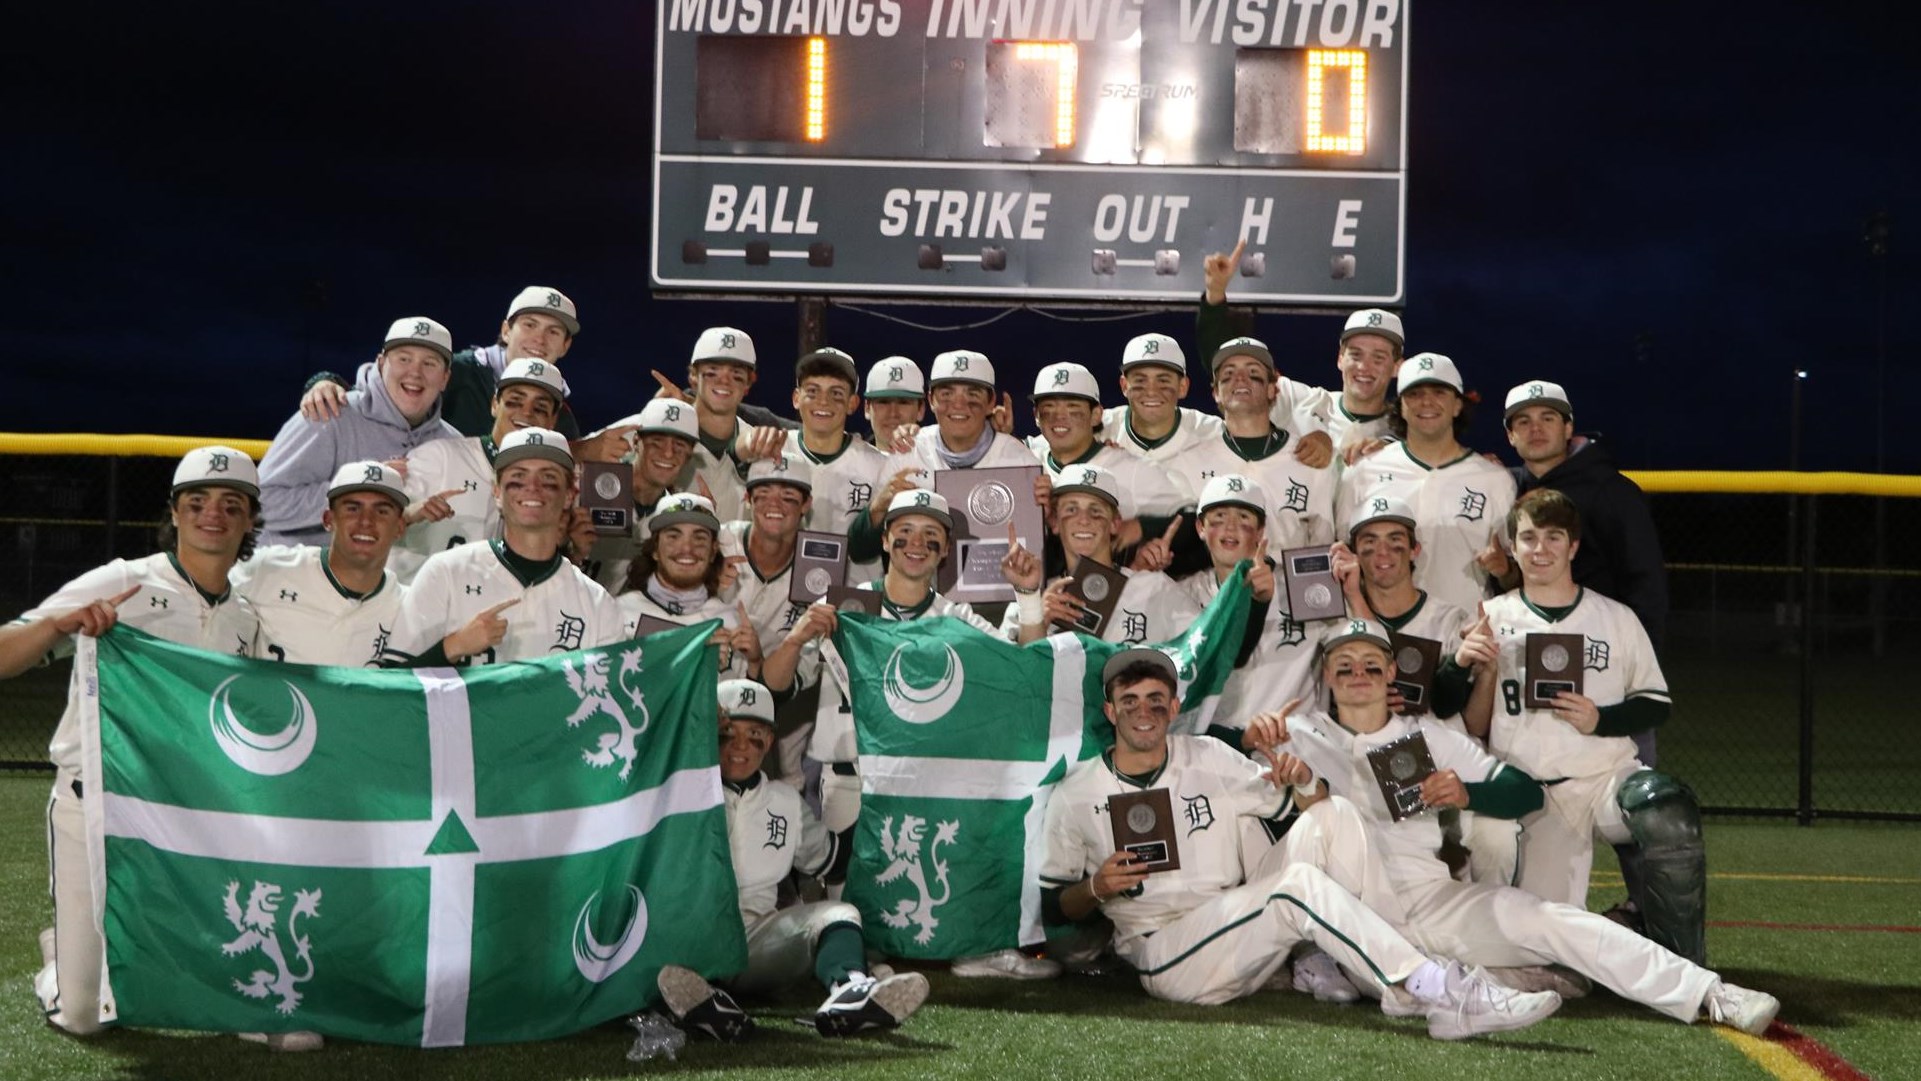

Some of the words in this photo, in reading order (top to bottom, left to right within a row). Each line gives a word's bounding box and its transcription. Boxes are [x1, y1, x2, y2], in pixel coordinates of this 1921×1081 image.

[669, 0, 901, 36] MUSTANGS
[926, 0, 1143, 42] INNING
[1179, 0, 1399, 48] VISITOR
[807, 37, 824, 140] 1
[1014, 41, 1076, 146] 7
[1306, 50, 1366, 152] 0
[704, 184, 819, 234] BALL
[880, 189, 1051, 240] STRIKE
[1093, 194, 1190, 243] OUT
[1239, 197, 1274, 245] H
[1332, 200, 1363, 247] E
[1279, 476, 1309, 512] D
[1455, 486, 1486, 522] D
[550, 609, 585, 651] D
[1120, 608, 1147, 644] D
[1502, 678, 1522, 716] 8
[762, 808, 788, 850] D
[1180, 794, 1215, 839] D
